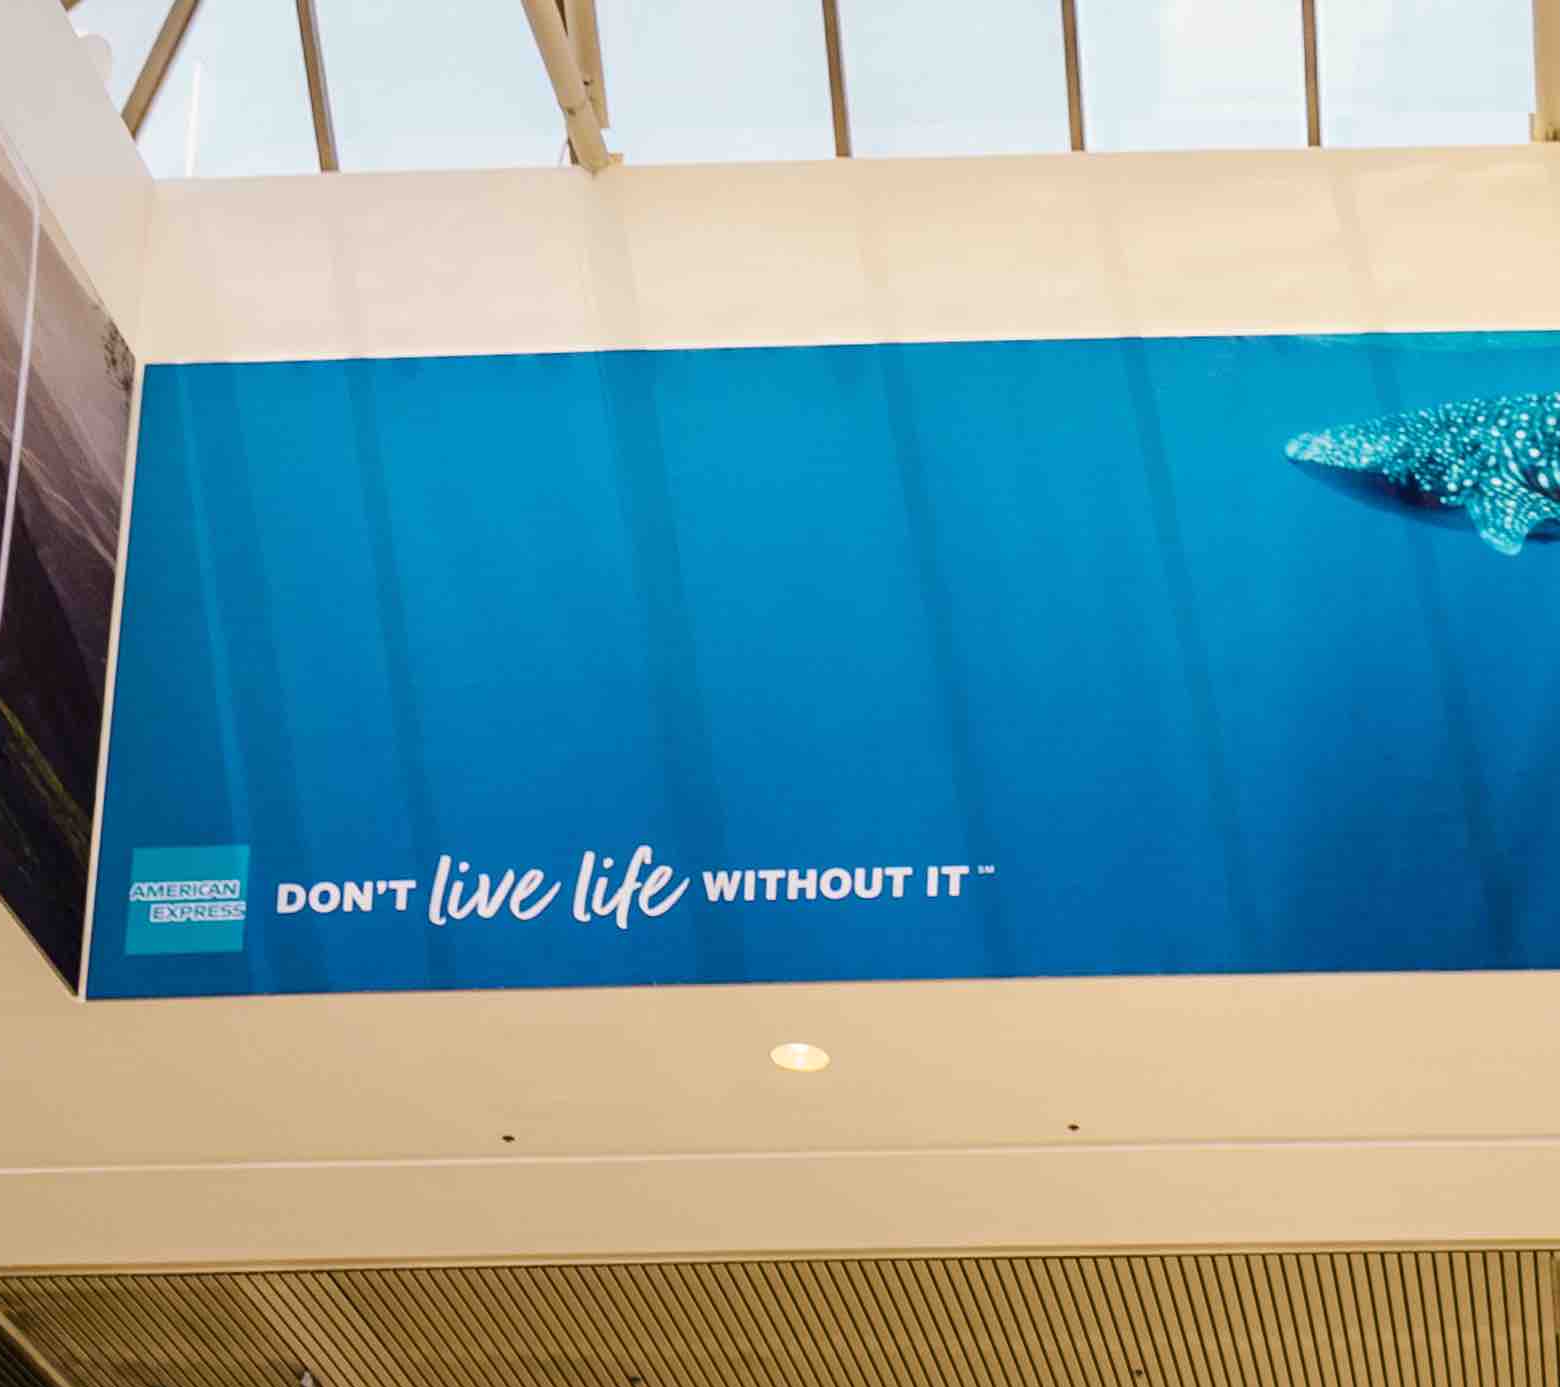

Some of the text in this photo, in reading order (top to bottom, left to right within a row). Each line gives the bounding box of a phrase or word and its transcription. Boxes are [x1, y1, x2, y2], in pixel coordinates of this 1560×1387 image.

[130, 880, 237, 901] AMERICAN
[276, 878, 416, 915] DON'T
[429, 854, 561, 928] live
[574, 844, 692, 929] life
[703, 865, 912, 903] WITHOUT
[150, 901, 245, 923] EXPRESS
